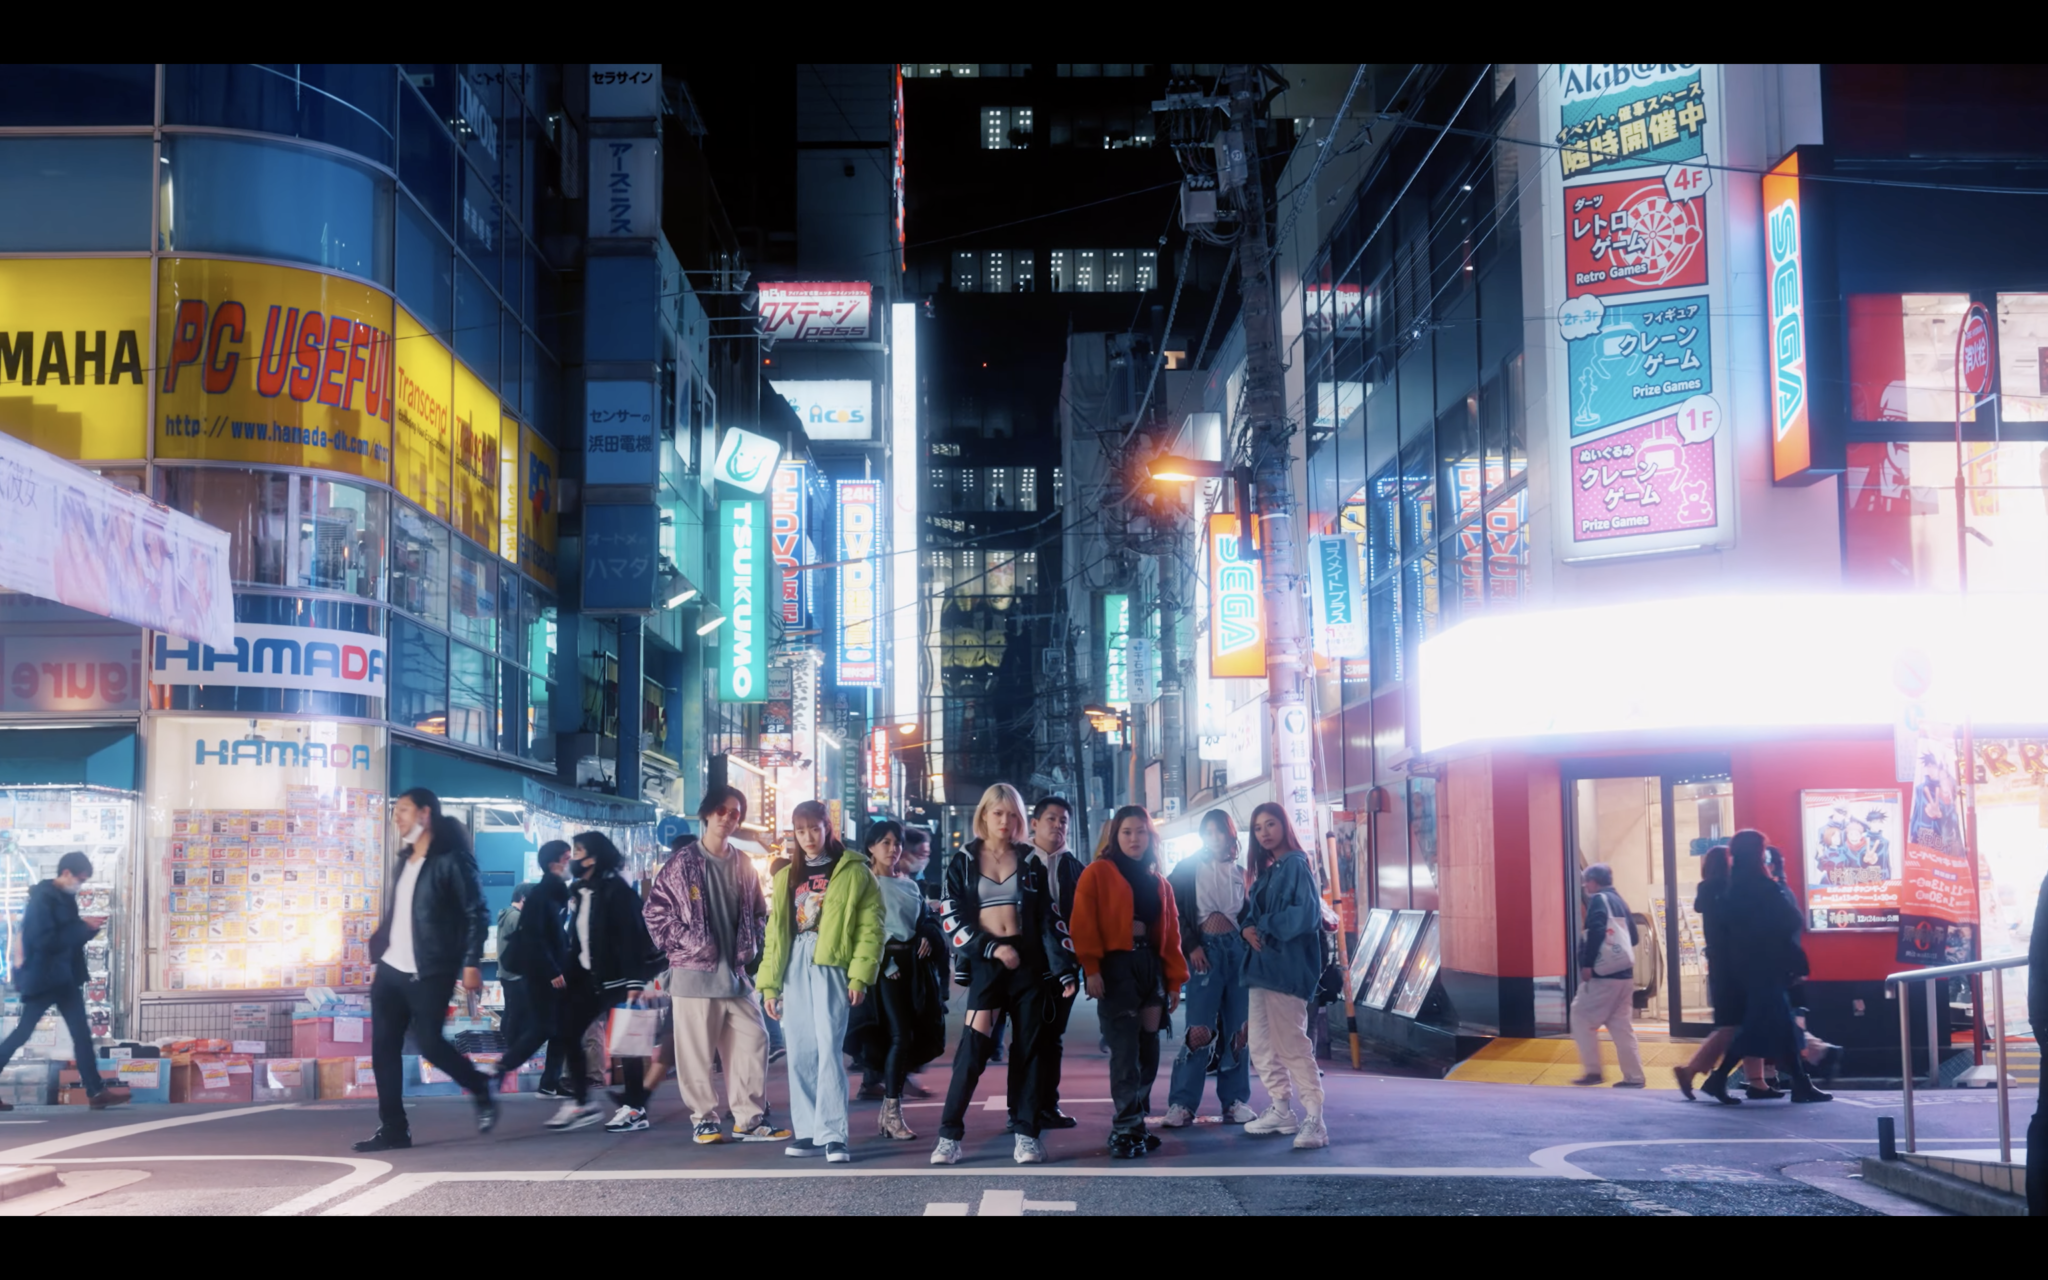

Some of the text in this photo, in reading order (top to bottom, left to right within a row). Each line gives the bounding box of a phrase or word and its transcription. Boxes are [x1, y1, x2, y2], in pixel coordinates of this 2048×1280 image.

[592, 71, 653, 85] セラサイン
[608, 142, 633, 234] アースニクス
[1673, 168, 1703, 191] 4F
[1574, 195, 1604, 212] ダーツ
[1573, 210, 1628, 240] レトロ
[1591, 231, 1647, 260] ゲーム
[1576, 263, 1647, 285] Retro Games
[1643, 304, 1699, 326] フィギュア
[1769, 198, 1804, 442] SEGA
[801, 327, 867, 339] pass
[1619, 326, 1698, 356] クレーン
[163, 299, 390, 423] PC USEFUL
[1643, 349, 1701, 376] ゲーム
[1965, 337, 1986, 374] 消火栓
[398, 366, 448, 436] Transcend
[1633, 379, 1701, 399] Prize Games
[589, 409, 650, 423] センサーの
[587, 435, 653, 453] 浜田電機
[1580, 444, 1634, 463] ぬいぐるみ
[1580, 462, 1658, 490] クレーン
[842, 488, 874, 502] 24H
[1604, 485, 1660, 511] ゲーム
[1582, 516, 1649, 532] Prize Games
[587, 556, 649, 580] ハマダ
[1216, 534, 1260, 656] SEGA
[1325, 540, 1349, 625] コスメイトプラス
[732, 502, 753, 699] TSUKUMO
[155, 634, 385, 684] HAMADA
[768, 724, 784, 734] 2F
[195, 739, 370, 770] HAMADA
[664, 825, 677, 846] P
[812, 878, 829, 890] CRE
